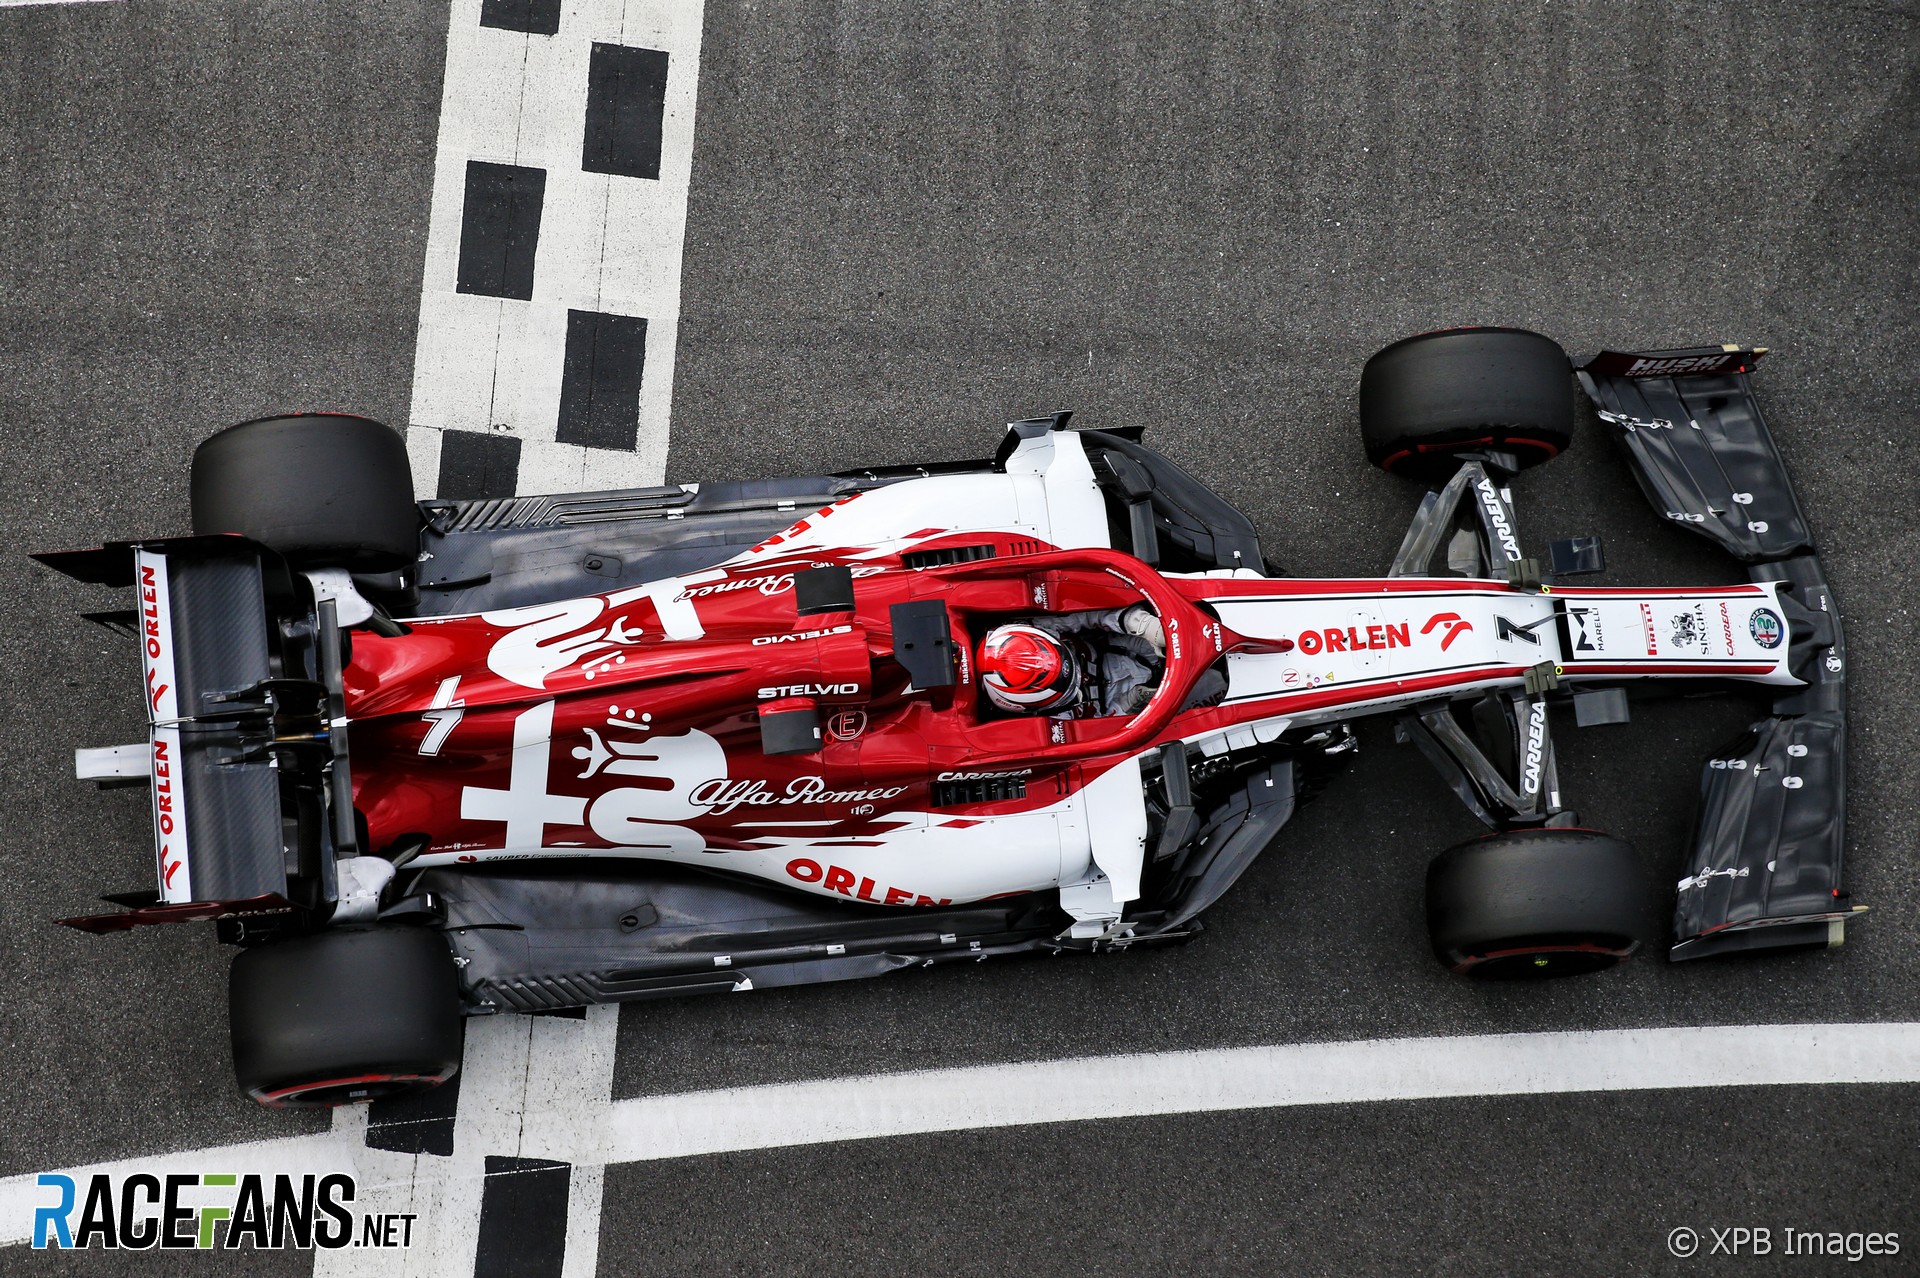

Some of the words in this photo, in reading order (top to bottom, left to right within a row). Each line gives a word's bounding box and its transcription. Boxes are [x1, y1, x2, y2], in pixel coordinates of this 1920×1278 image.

[1625, 365, 1718, 377] CHOCOLATE
[1631, 355, 1733, 371] HUSKI
[1477, 478, 1522, 562] CARRERA
[140, 566, 161, 660] ORLEN
[1820, 594, 1828, 612] dren
[752, 625, 852, 647] STELVIO
[1171, 632, 1182, 661] ORLEN
[1212, 622, 1223, 652] ORLEN
[1299, 622, 1411, 657] ORLEN
[1493, 613, 1542, 647] 7
[1593, 606, 1605, 651] MARELLI
[1640, 603, 1658, 656] PIRELLI
[1693, 602, 1710, 656] SINGHA
[1719, 601, 1735, 656] CARRERA
[757, 682, 859, 700] STELVIO
[418, 675, 465, 757] 7
[1525, 702, 1546, 795] CARRERA
[154, 740, 173, 836] ORLEN
[688, 778, 782, 816] Alfa
[778, 774, 908, 807] Romeo
[937, 768, 1033, 782] CARRERA
[785, 857, 953, 907] ORLEN
